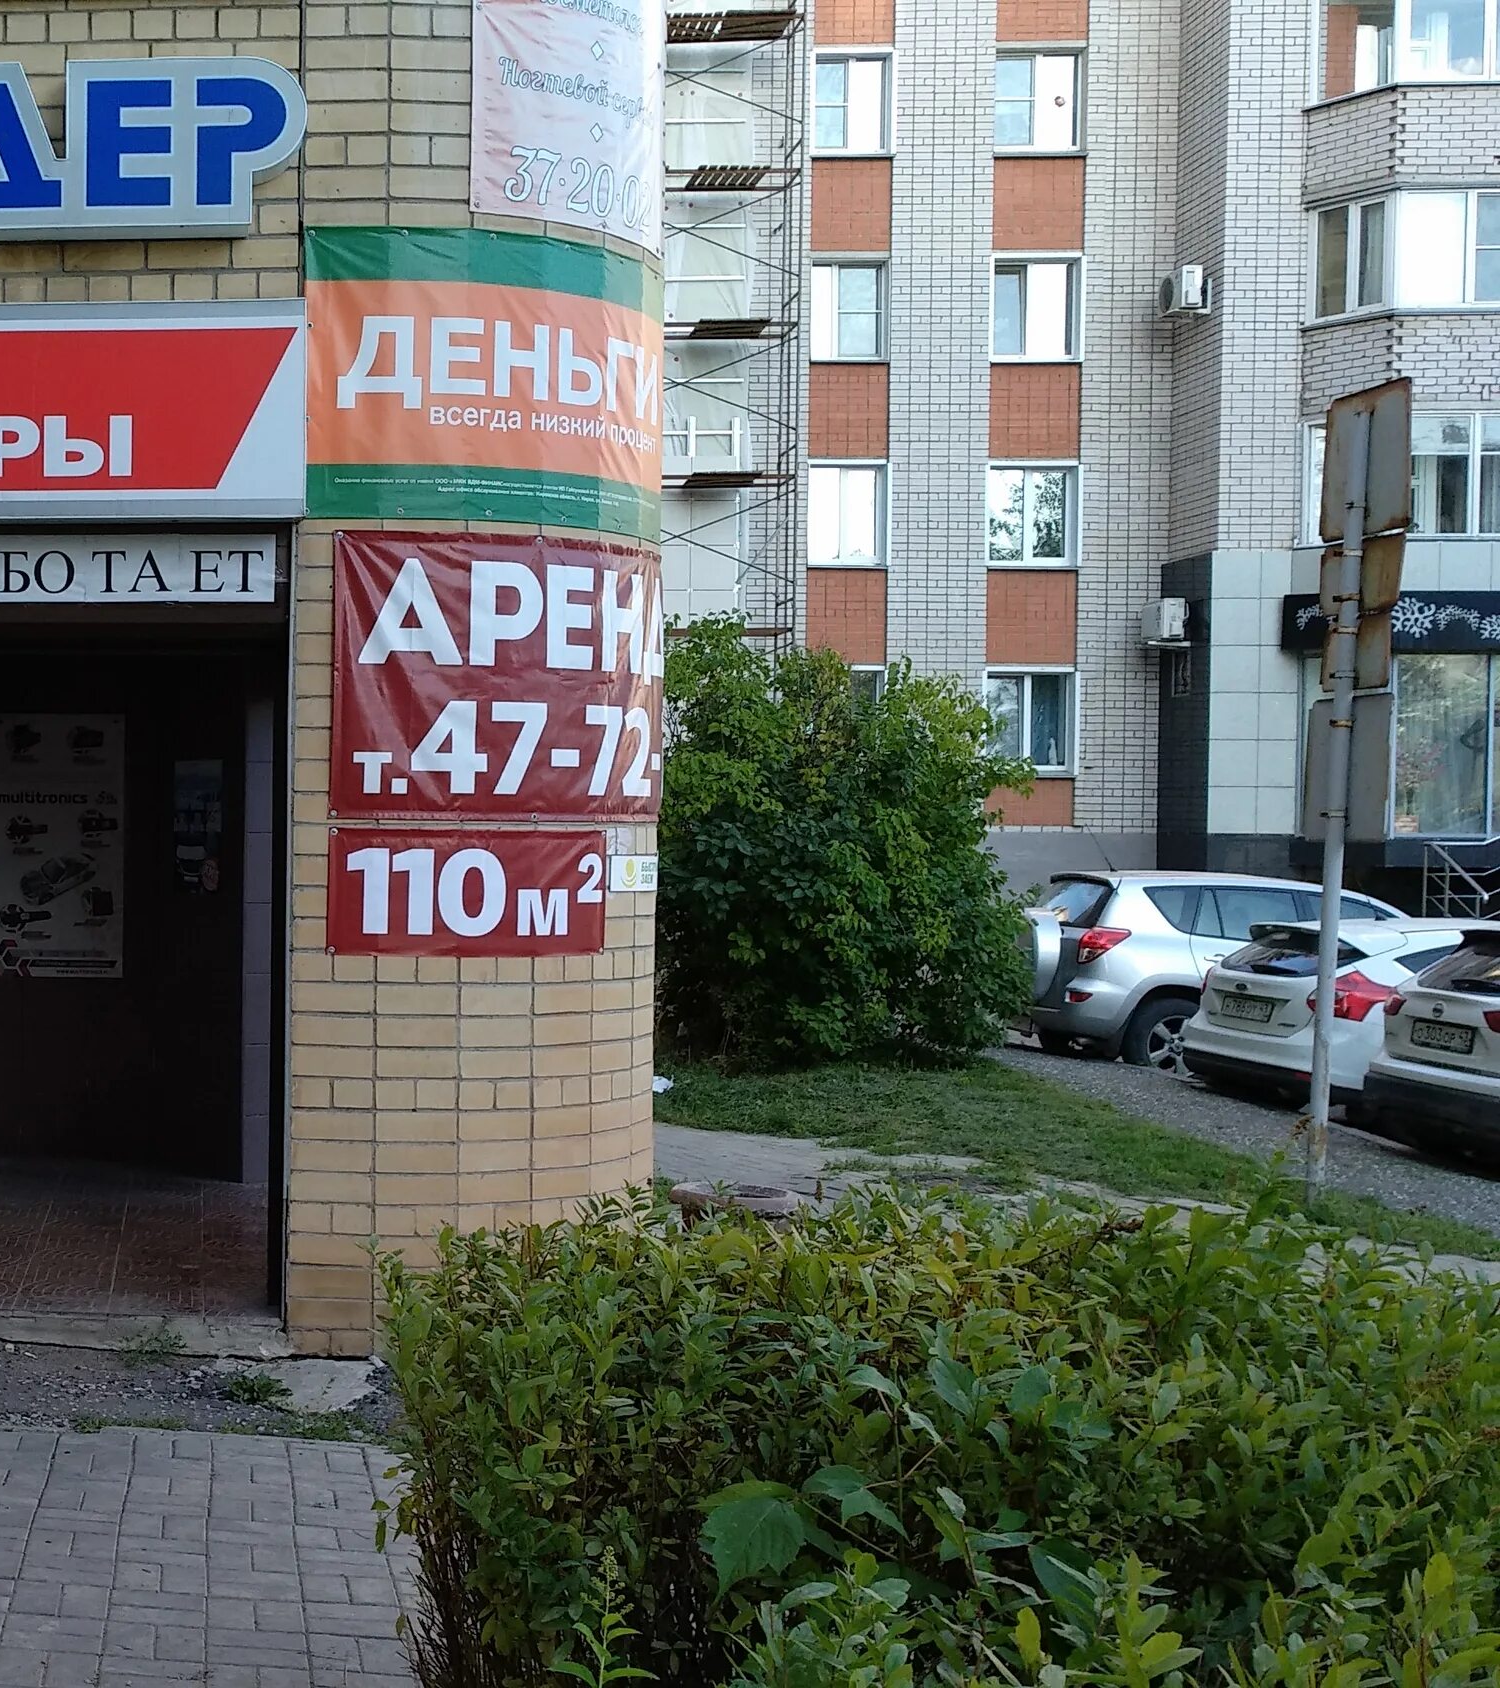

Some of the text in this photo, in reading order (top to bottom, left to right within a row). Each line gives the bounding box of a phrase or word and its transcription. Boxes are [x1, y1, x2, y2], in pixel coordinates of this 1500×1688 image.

[499, 56, 609, 107] Ногтевой
[336, 315, 658, 426] ДЕНЬГИ
[429, 406, 657, 454] всегда низкий процент
[346, 847, 507, 937] 110
